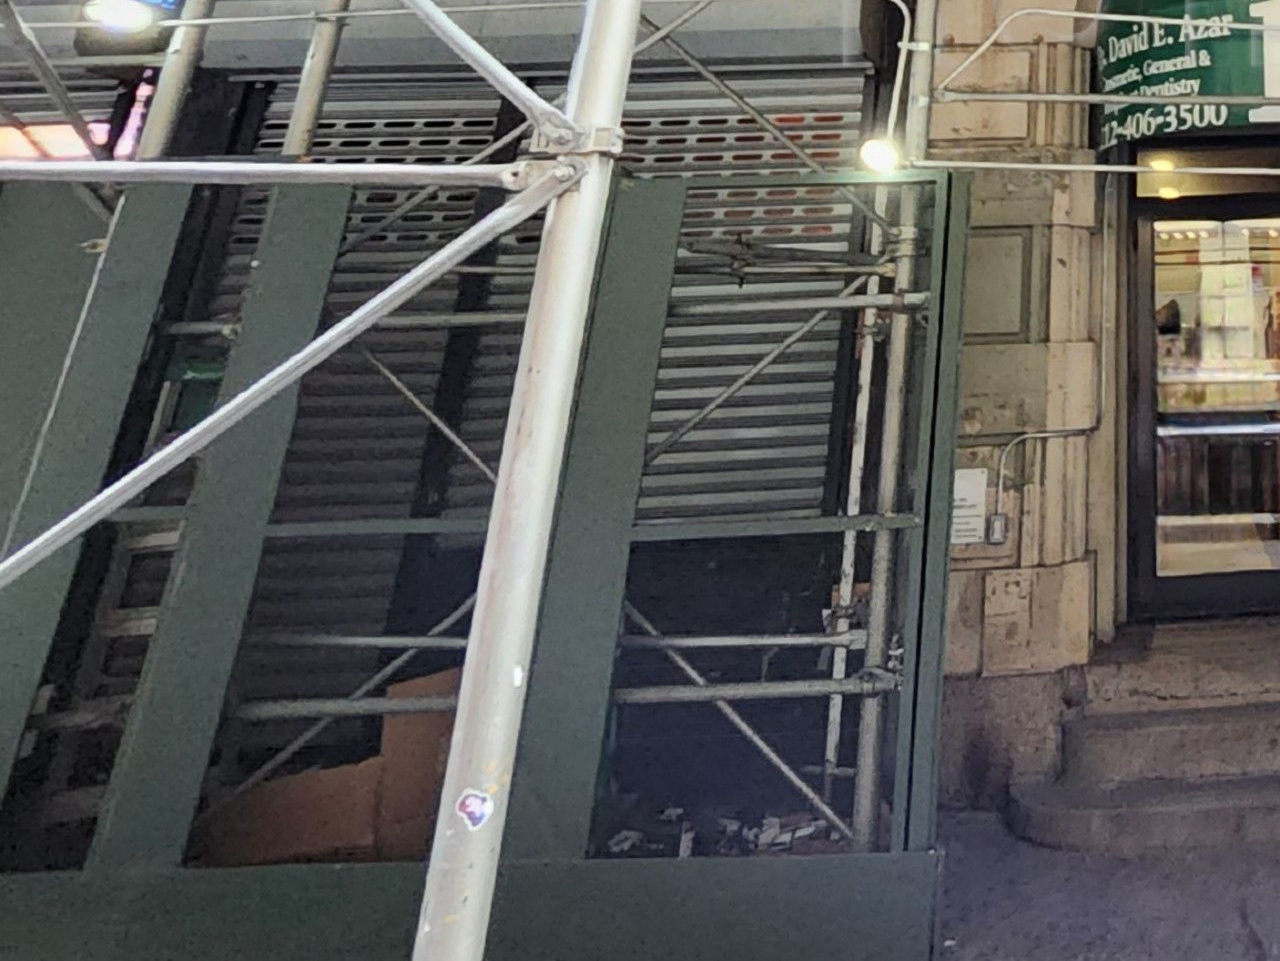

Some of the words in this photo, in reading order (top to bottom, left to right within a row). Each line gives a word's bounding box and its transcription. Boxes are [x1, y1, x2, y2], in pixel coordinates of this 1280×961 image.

[1108, 22, 1149, 63] David
[1152, 22, 1174, 47] E.
[1179, 13, 1234, 43] Azar
[1143, 49, 1197, 76] General
[1199, 49, 1212, 67] &
